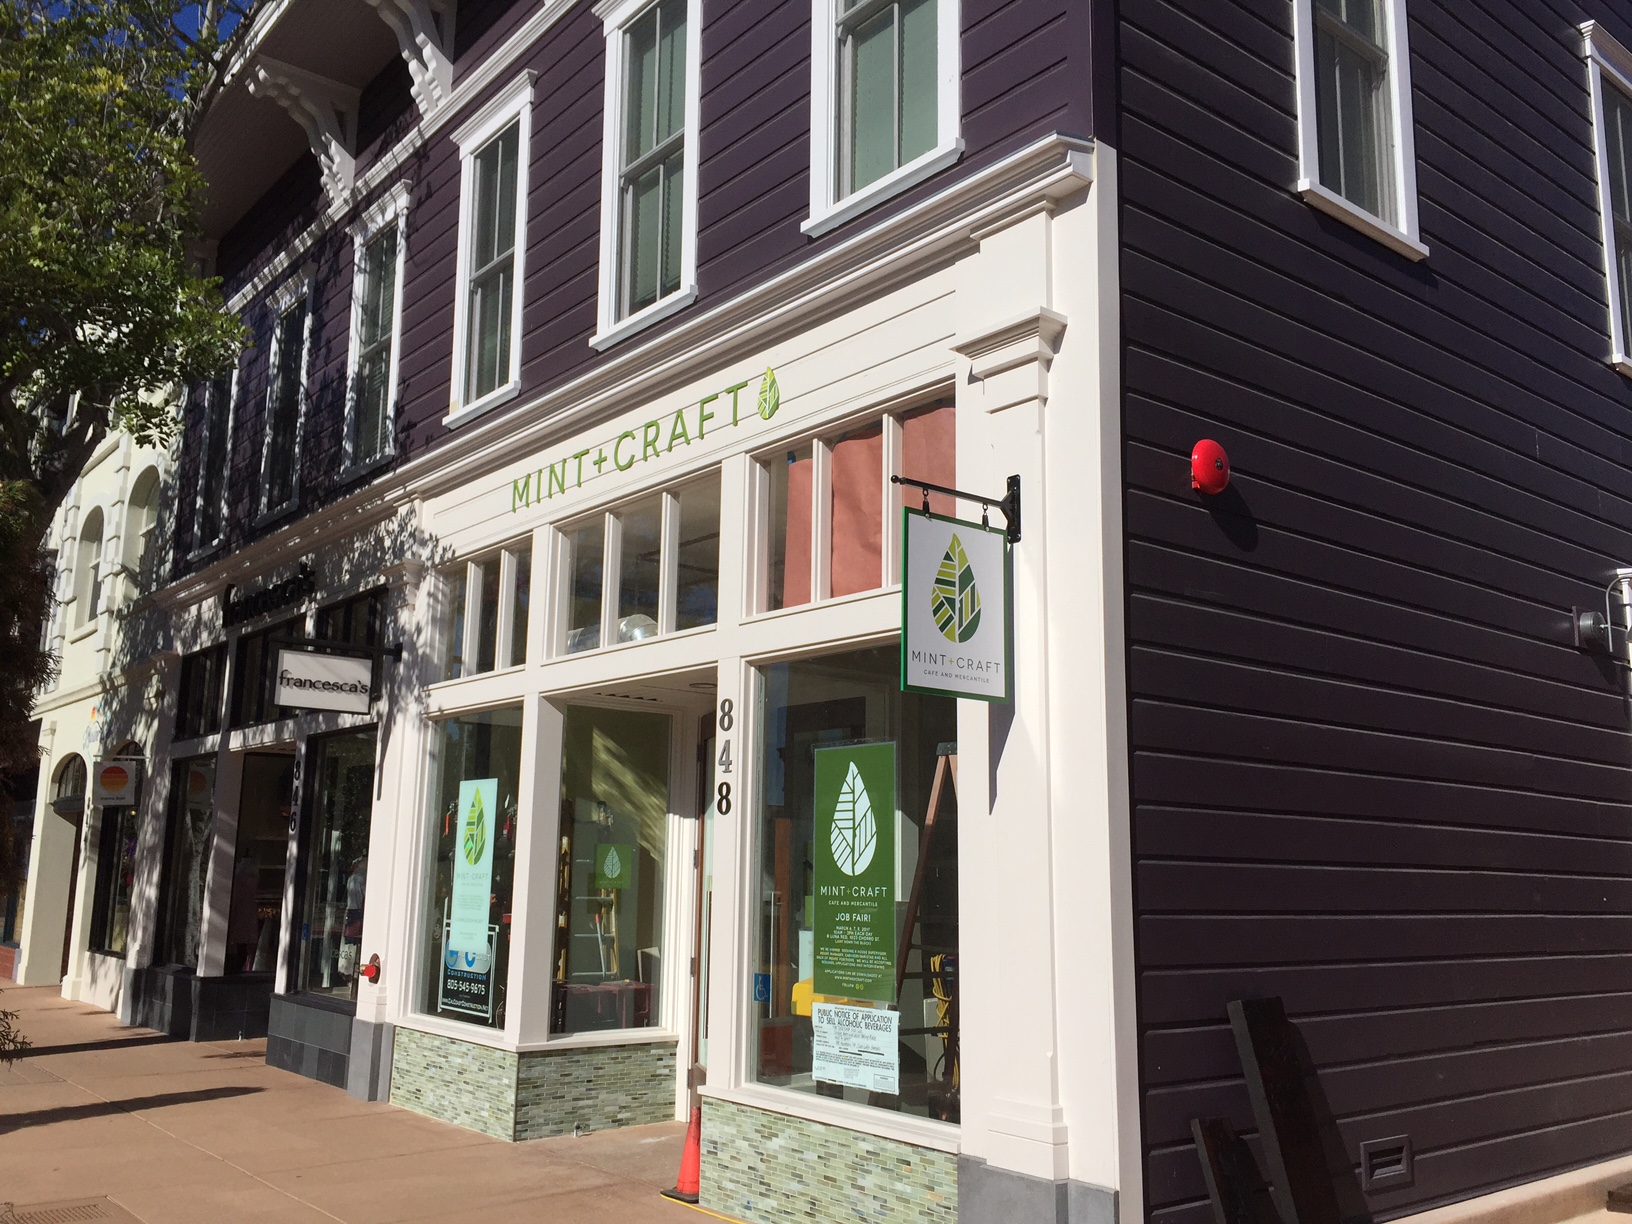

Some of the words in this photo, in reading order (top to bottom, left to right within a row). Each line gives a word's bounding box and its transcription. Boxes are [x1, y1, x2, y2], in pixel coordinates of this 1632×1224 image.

[512, 380, 749, 513] MINT+CRAFT
[911, 650, 1001, 674] MINT+CRAFT
[279, 669, 369, 694] francesca's
[954, 674, 990, 684] MERCANTILE
[717, 698, 733, 815] 848
[289, 760, 300, 832] 846
[820, 886, 888, 898] MINT+CRAFT
[835, 912, 850, 921] JOB
[852, 913, 871, 922] FAIR!
[447, 969, 486, 980] CONSTRUCTION
[447, 979, 485, 995] 805-545-9675
[818, 1008, 832, 1018] PUBLIC
[834, 1010, 850, 1020] NOTICE
[861, 1013, 892, 1024] APPLICATION
[826, 1017, 836, 1025] SELL
[837, 1018, 863, 1029] ALCOHOLIC
[865, 1022, 892, 1033] BEVERAGES
